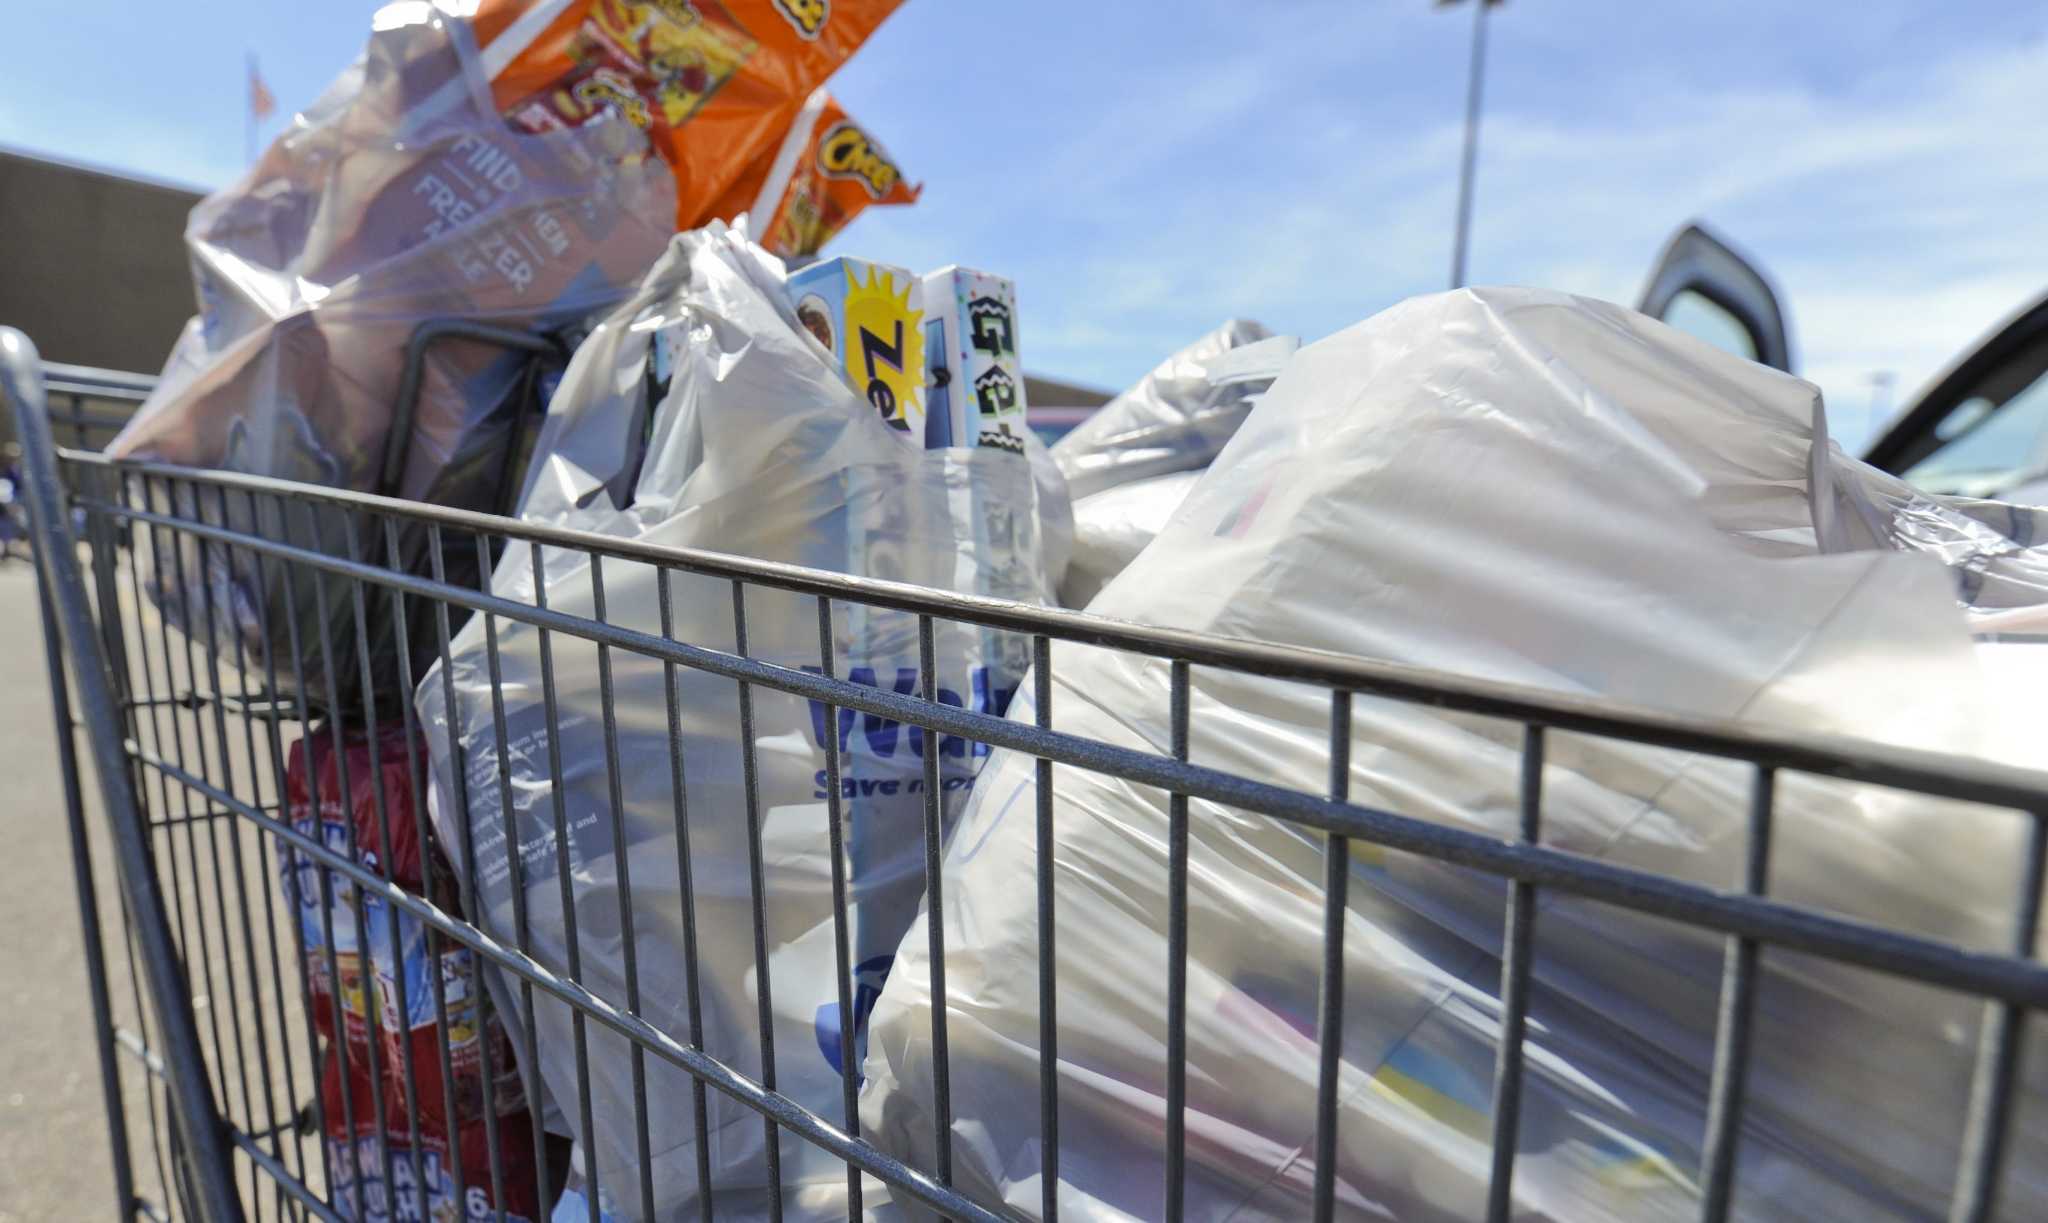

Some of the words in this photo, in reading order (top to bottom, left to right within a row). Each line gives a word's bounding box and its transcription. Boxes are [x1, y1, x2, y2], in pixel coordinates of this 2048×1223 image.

[451, 132, 522, 192] FIND
[413, 173, 533, 294] FREZER
[814, 769, 900, 800] Save
